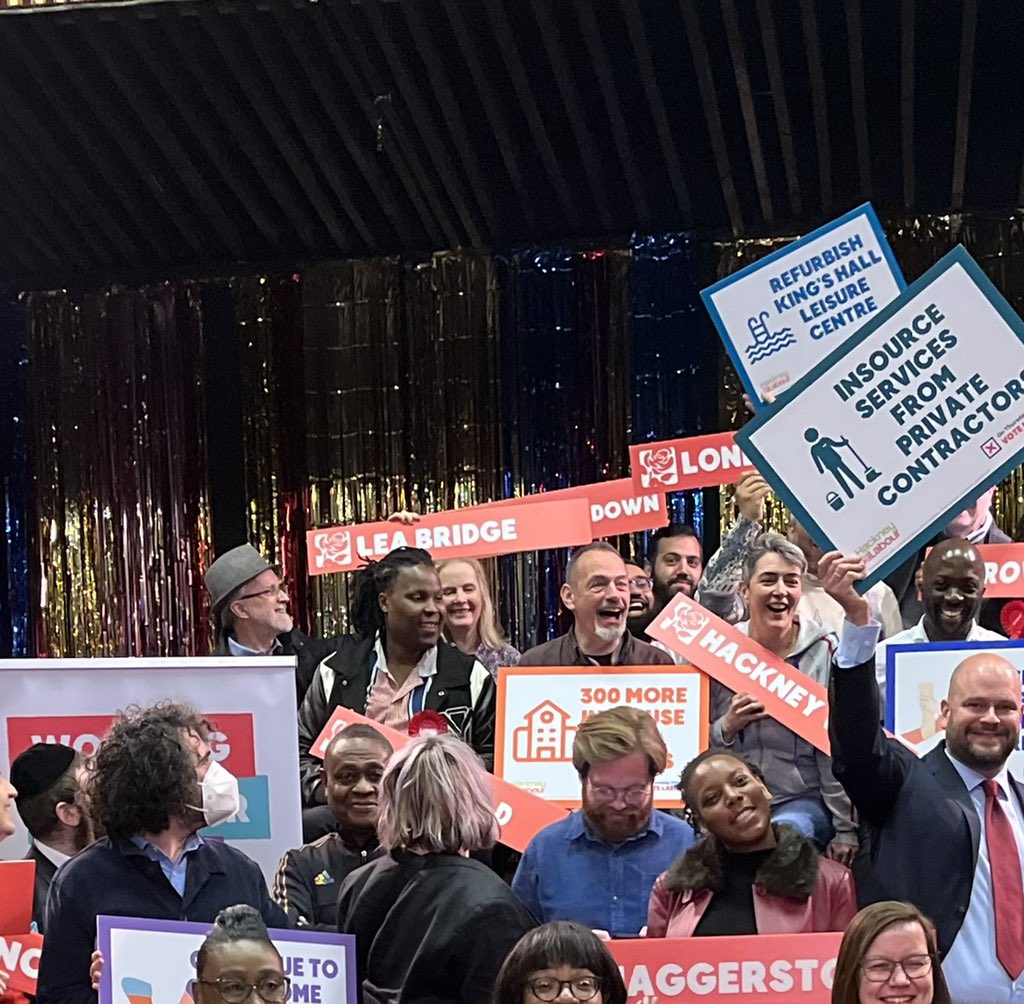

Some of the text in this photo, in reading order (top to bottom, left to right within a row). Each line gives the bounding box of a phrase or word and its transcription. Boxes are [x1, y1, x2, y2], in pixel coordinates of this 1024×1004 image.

[769, 234, 863, 294] REFURBISH
[774, 250, 882, 314] KING'S HALL
[799, 277, 870, 323] LEISURE
[810, 296, 877, 340] CENTRE
[833, 303, 945, 402] INSOURCE
[855, 329, 958, 419] SERVICES
[889, 365, 957, 426] FROM
[895, 373, 989, 457] PRIVATE
[1002, 425, 1023, 445] VOTE
[681, 445, 753, 475] LON
[591, 494, 660, 522] DOWN
[356, 518, 517, 557] LEA BRIDGE
[580, 687, 688, 704] 300 MORE
[700, 629, 825, 717] HACKNEY
[309, 959, 339, 979] TO
